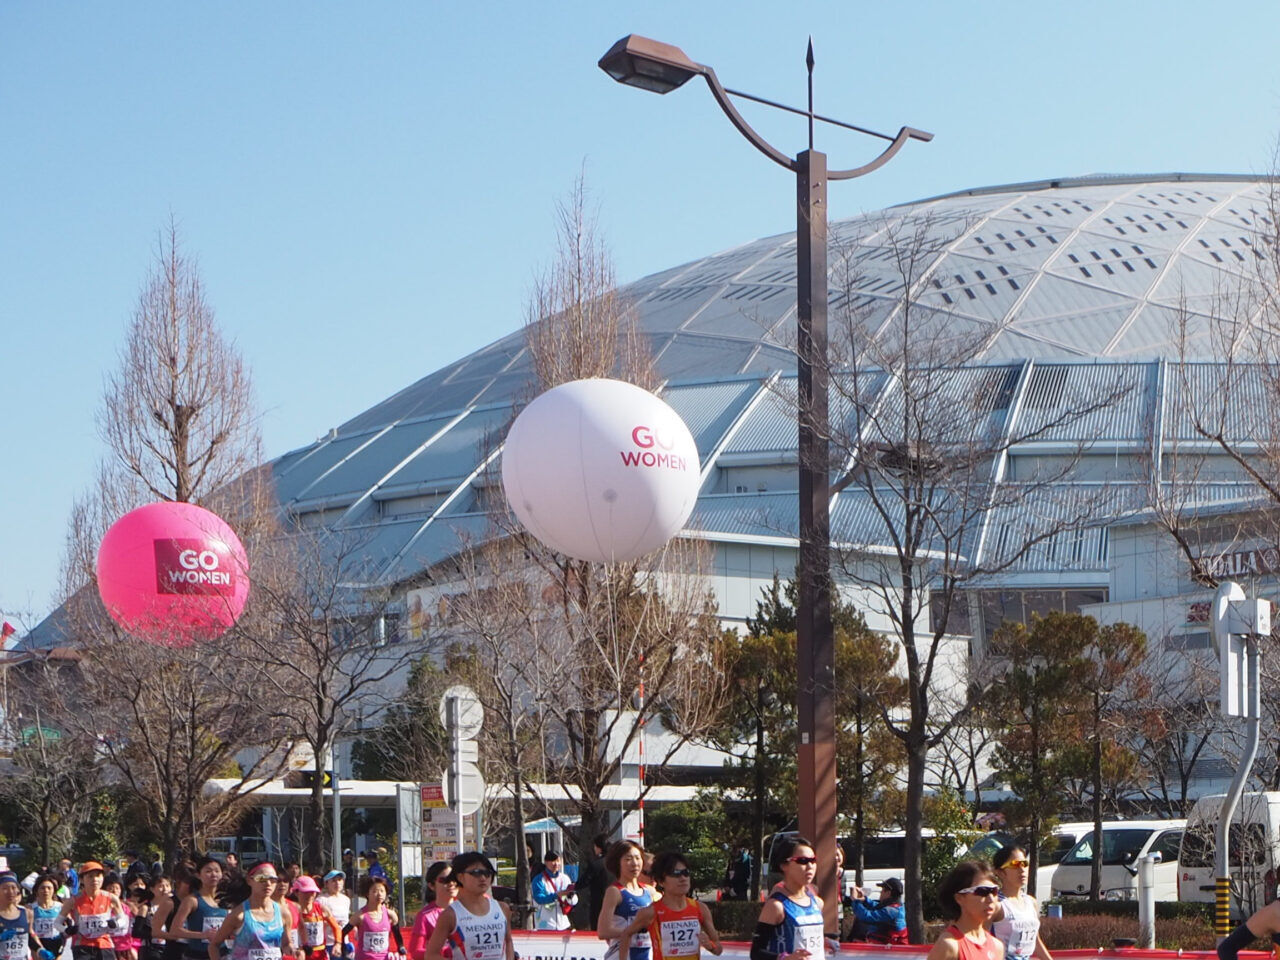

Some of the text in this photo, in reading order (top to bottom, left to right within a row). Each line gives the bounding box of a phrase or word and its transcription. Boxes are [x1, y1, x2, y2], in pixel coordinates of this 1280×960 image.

[631, 425, 674, 451] GO
[620, 451, 687, 471] WOMEN
[179, 549, 219, 571] GO
[168, 570, 231, 585] WOMEN
[466, 923, 503, 932] MENARD
[662, 921, 699, 929] MENARD
[474, 932, 500, 945] 121
[670, 929, 694, 942] 127
[1019, 930, 1036, 941] 112
